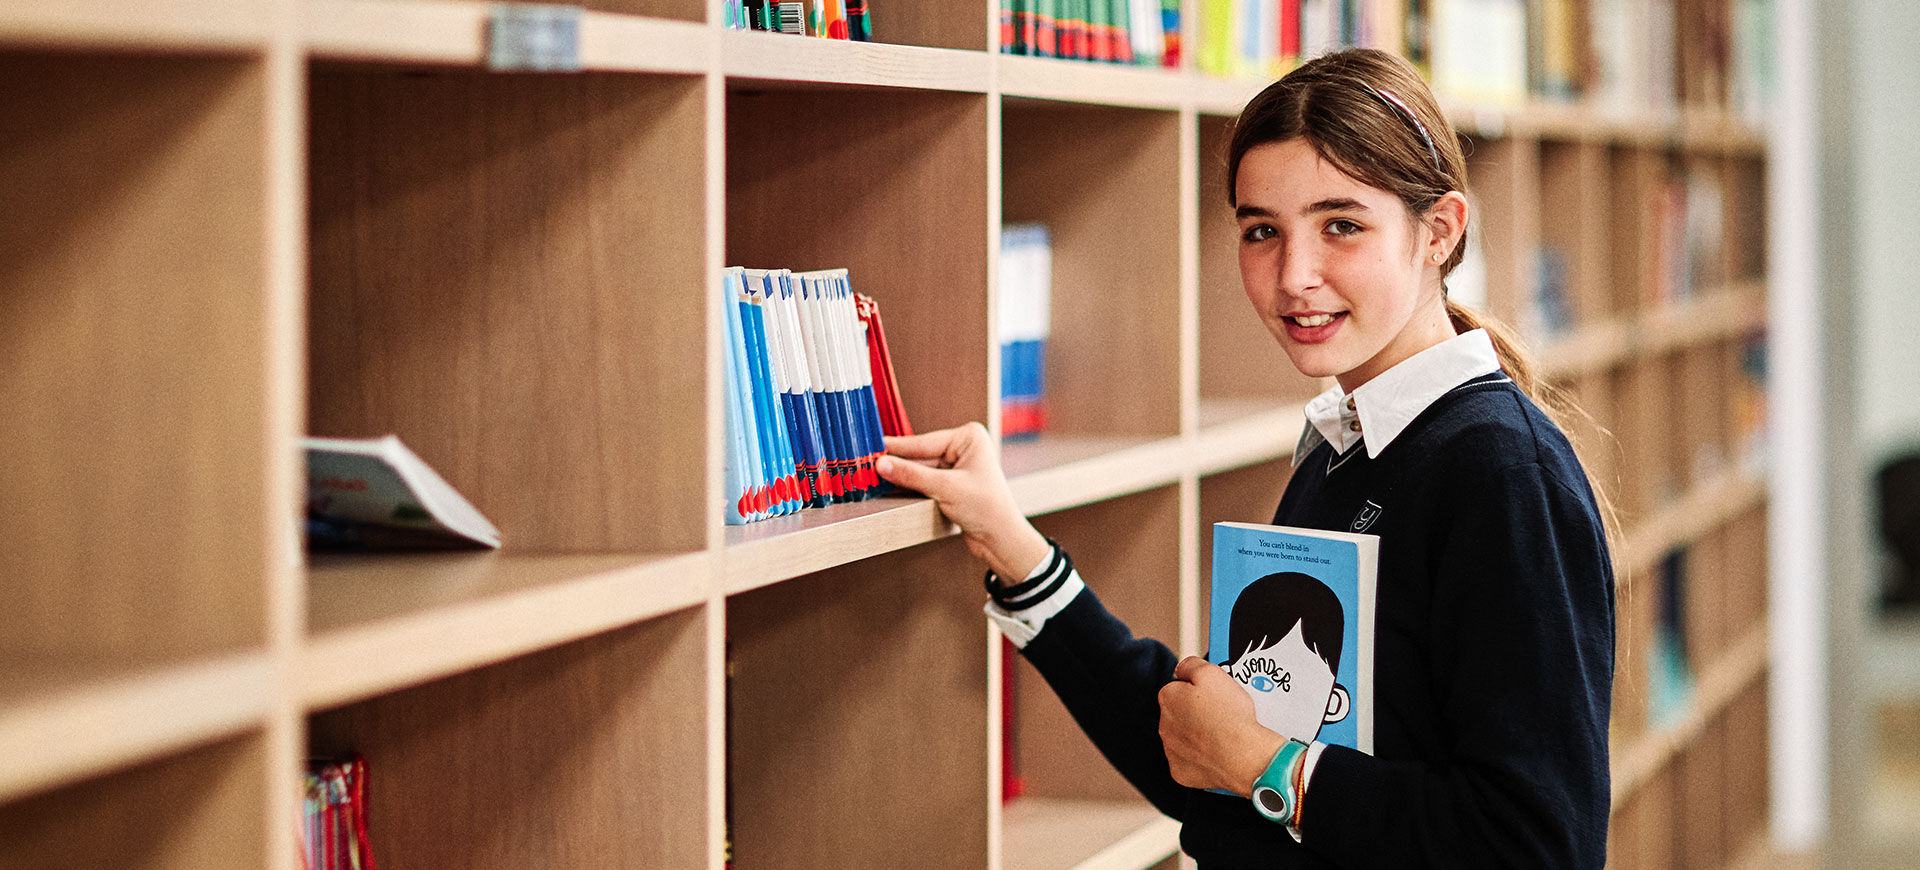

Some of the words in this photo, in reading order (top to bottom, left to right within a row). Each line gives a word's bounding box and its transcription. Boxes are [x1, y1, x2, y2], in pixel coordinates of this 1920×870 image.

[1258, 539, 1270, 548] You
[1286, 543, 1301, 551] blend
[1237, 547, 1253, 556] when
[1253, 550, 1264, 558] you
[1280, 552, 1294, 560] born
[1234, 656, 1292, 693] WONDER
